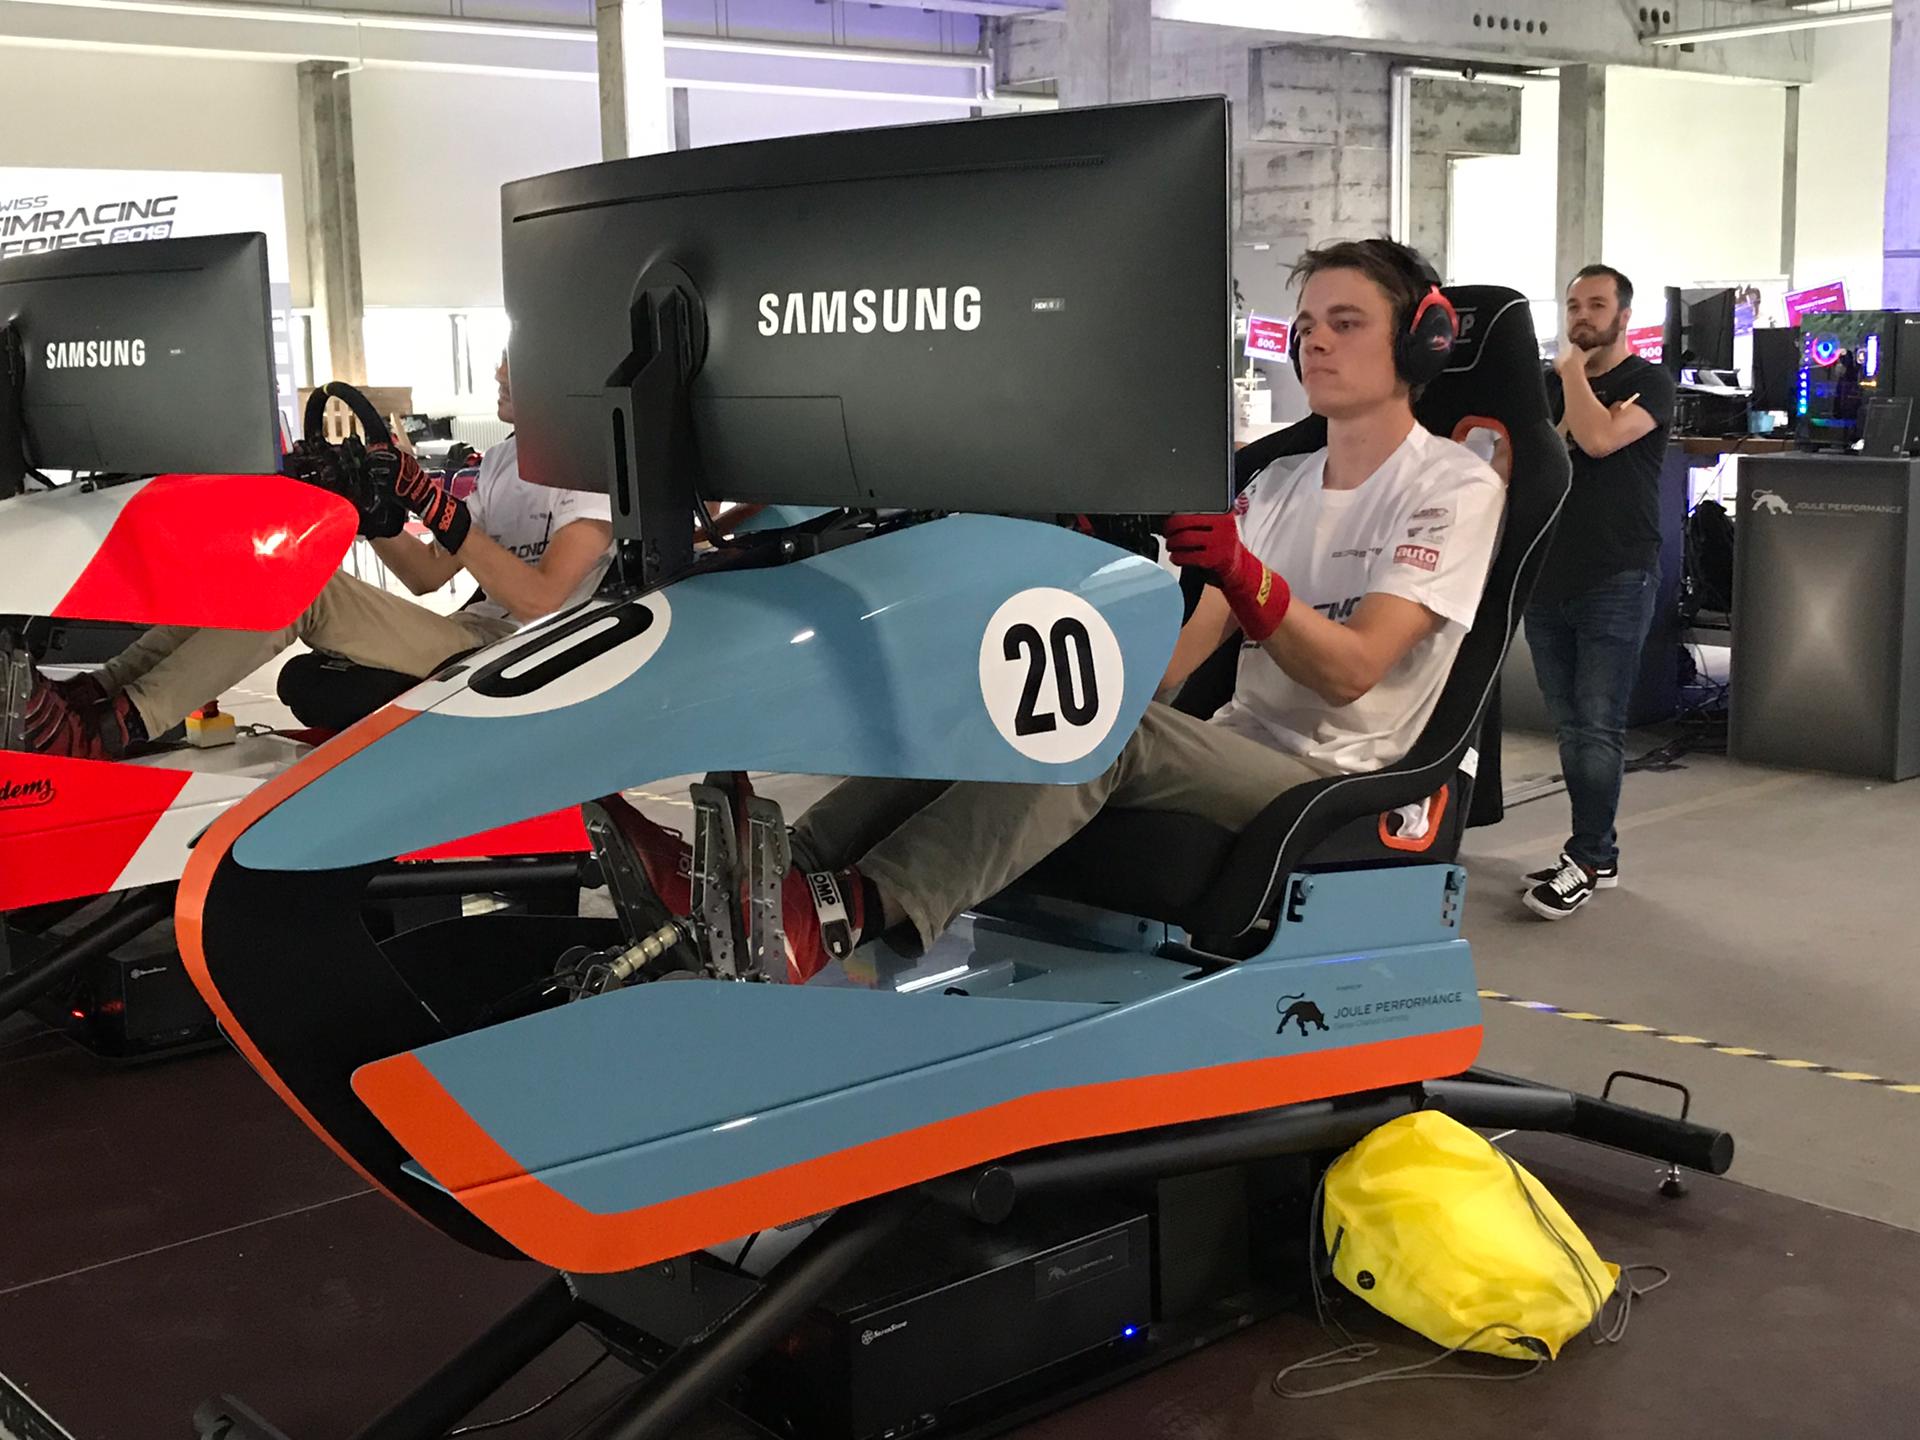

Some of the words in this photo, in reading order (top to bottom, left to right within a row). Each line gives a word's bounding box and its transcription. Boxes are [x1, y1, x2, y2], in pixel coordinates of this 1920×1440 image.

[0, 195, 178, 237] IMRACING
[112, 223, 168, 243] 2019
[757, 285, 981, 337] SAMSUNG
[45, 339, 146, 369] SAMSUNG
[1795, 502, 1825, 510] JOULE
[1827, 502, 1903, 514] PERFORMANCE
[1396, 546, 1437, 563] auto
[1003, 616, 1099, 737] 20
[813, 874, 836, 905] OMP
[1333, 1003, 1373, 1019] JOULE
[1375, 991, 1462, 1013] PERFORMANCE
